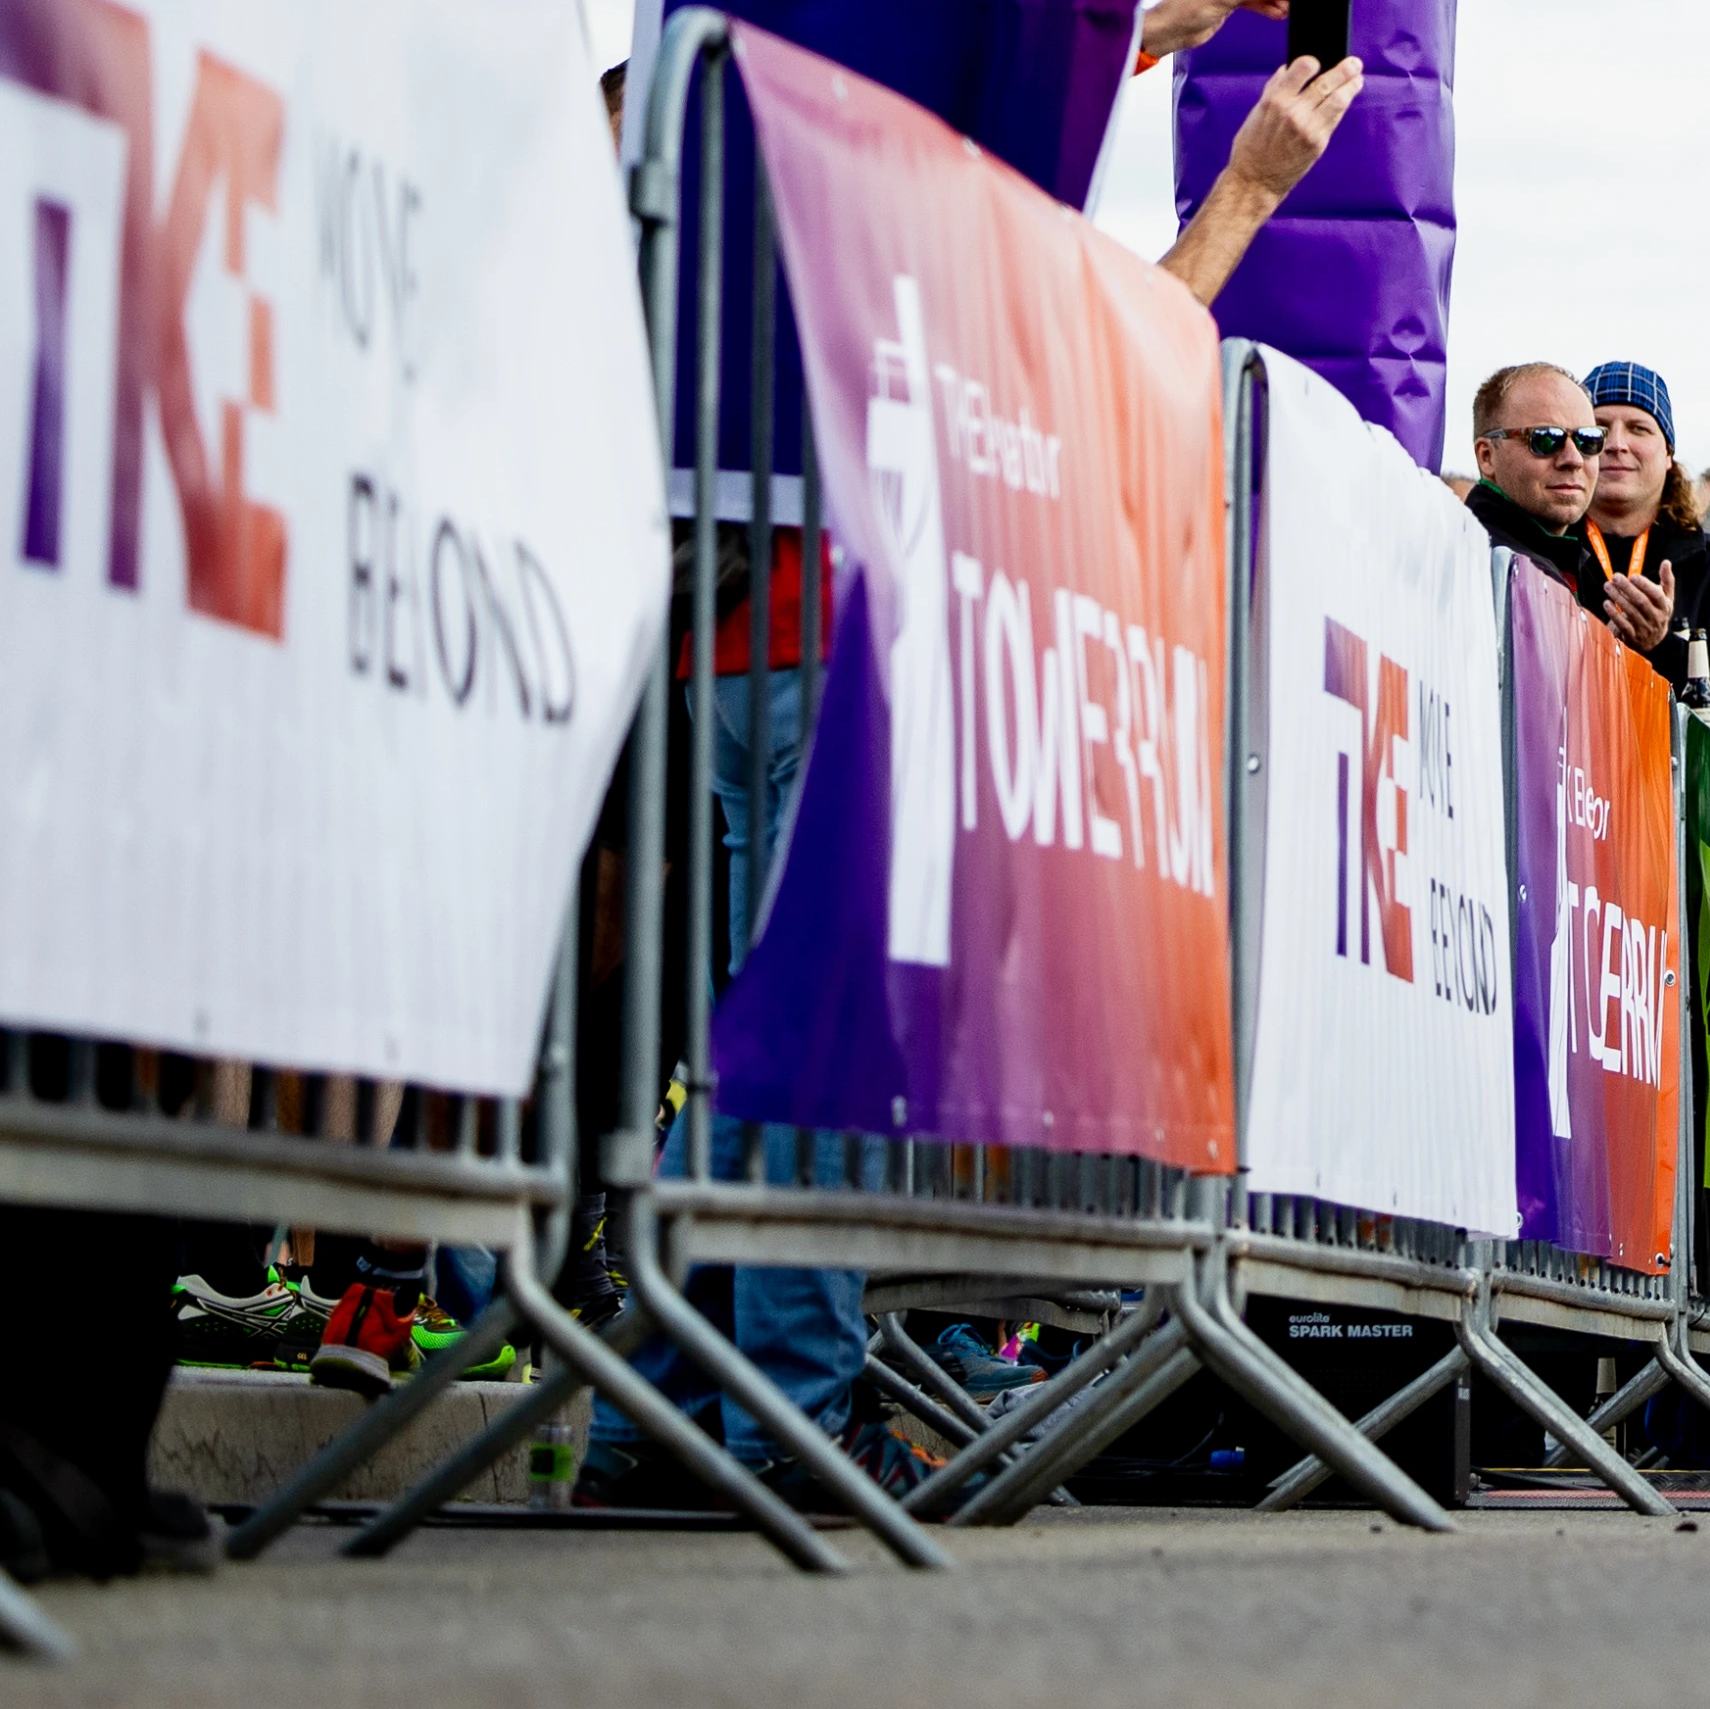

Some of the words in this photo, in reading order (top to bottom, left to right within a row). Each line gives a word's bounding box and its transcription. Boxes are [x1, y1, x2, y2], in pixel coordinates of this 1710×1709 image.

[952, 549, 1215, 898] TOWERRUN
[1324, 615, 1414, 983] TKE
[1566, 882, 1669, 1091] TOERRU
[1288, 1312, 1331, 1323] eurolite
[1288, 1324, 1344, 1338] SPARK
[1347, 1324, 1413, 1338] MASTER
